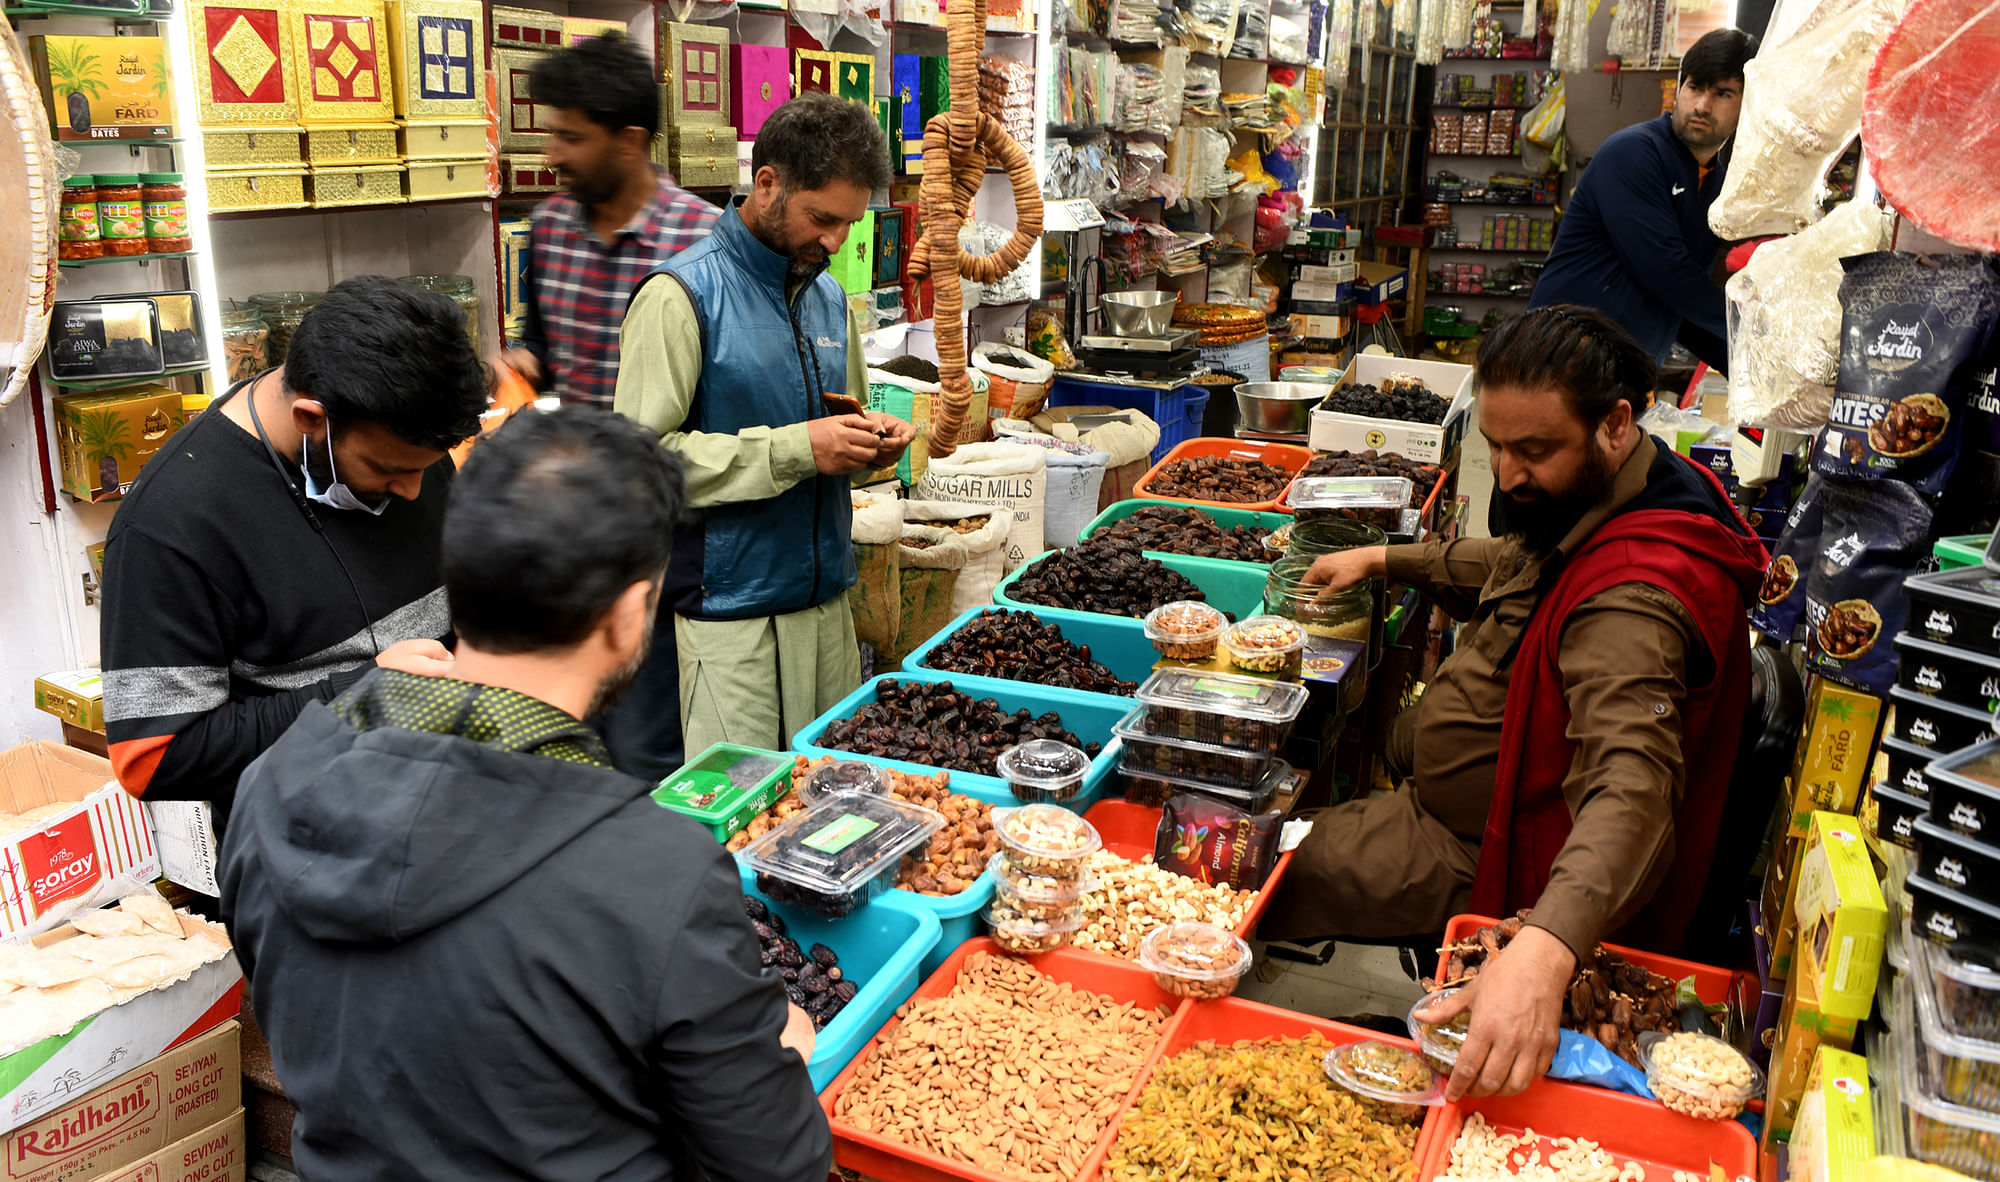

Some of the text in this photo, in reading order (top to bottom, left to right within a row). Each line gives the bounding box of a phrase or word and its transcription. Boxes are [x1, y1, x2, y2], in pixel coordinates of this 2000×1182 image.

[116, 64, 147, 75] Jardin
[115, 108, 158, 119] FARD
[90, 130, 119, 138] DATES
[1882, 319, 1920, 341] Royal
[1867, 334, 1922, 360] Jardin
[1829, 398, 1885, 427] ATES
[928, 472, 983, 498] SUGAR
[987, 479, 1033, 498] MILLS
[1013, 512, 1030, 522] INDIA
[1831, 729, 1850, 772] FARD
[194, 806, 209, 858] NUTRITION
[1212, 831, 1227, 871] Almond
[175, 1052, 217, 1082] SEVIYAN
[168, 1067, 224, 1105] LONG CUT
[175, 1087, 219, 1121] (ROASTED)
[17, 1083, 151, 1162] Rajdhani
[183, 1133, 229, 1168] SEVIYAN
[59, 1159, 79, 1174] 150g
[177, 1163, 210, 1182] ONG
[212, 1149, 235, 1175] CUT
